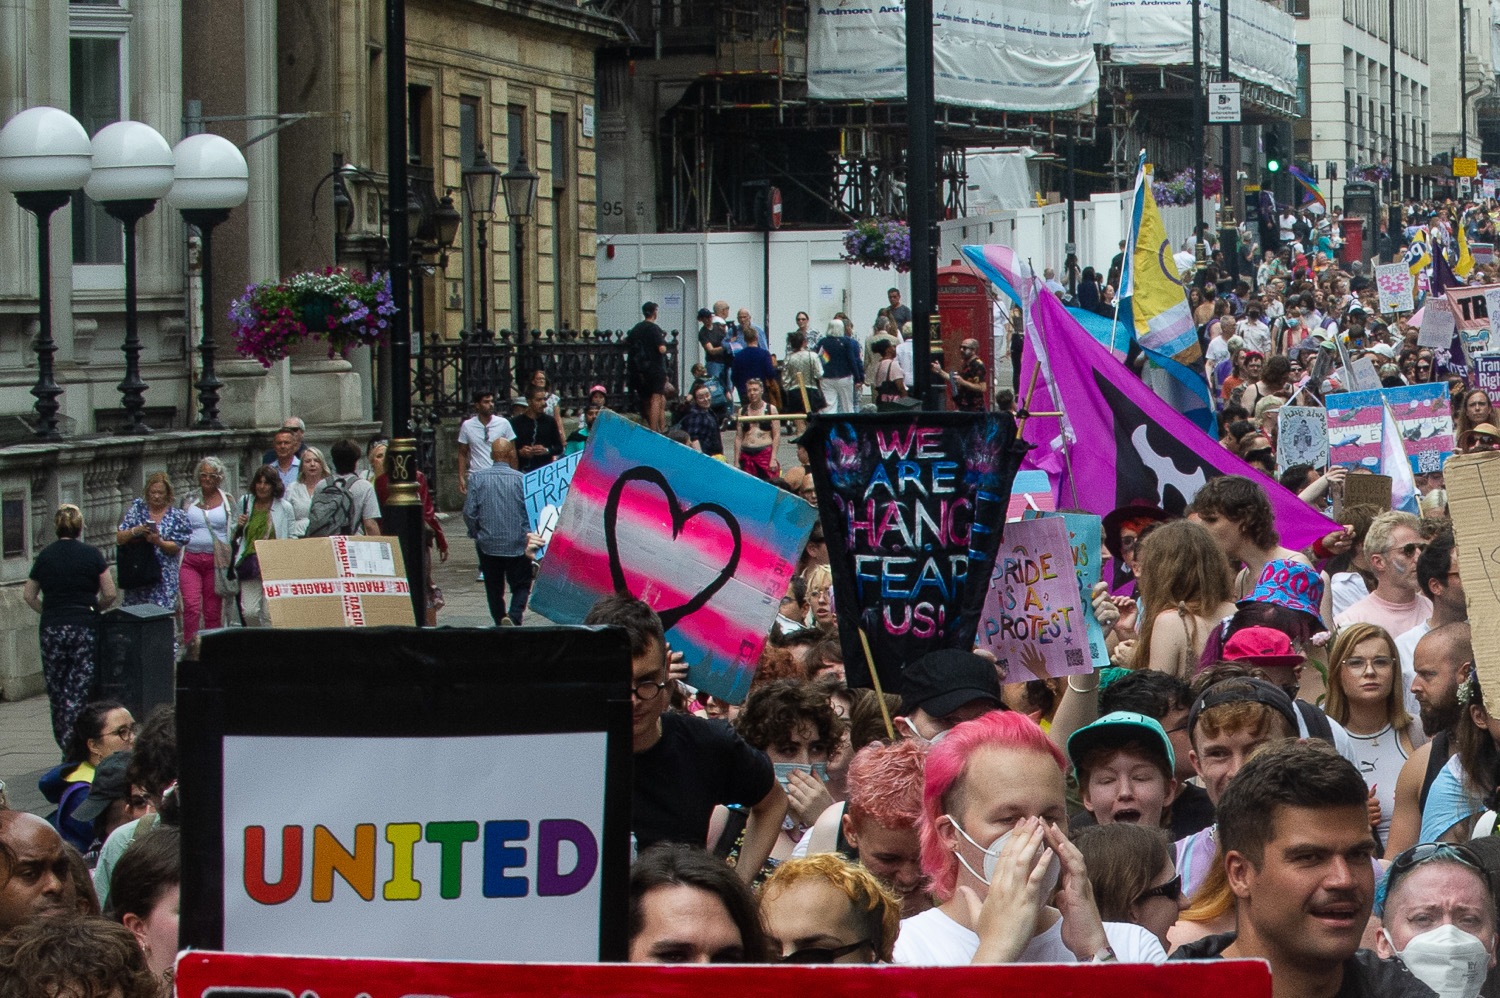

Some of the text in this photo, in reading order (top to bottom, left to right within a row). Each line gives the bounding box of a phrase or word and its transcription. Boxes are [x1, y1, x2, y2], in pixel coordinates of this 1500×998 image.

[818, 7, 873, 15] Ardmore
[876, 424, 946, 460] WE
[863, 460, 958, 500] ARE
[291, 582, 386, 596] FRAGILE FRAGILE
[990, 553, 1058, 589] PRIDE
[1024, 586, 1043, 612] A
[882, 601, 945, 638] US!
[985, 606, 1074, 645] PROTEST
[243, 818, 600, 906] UNITED
